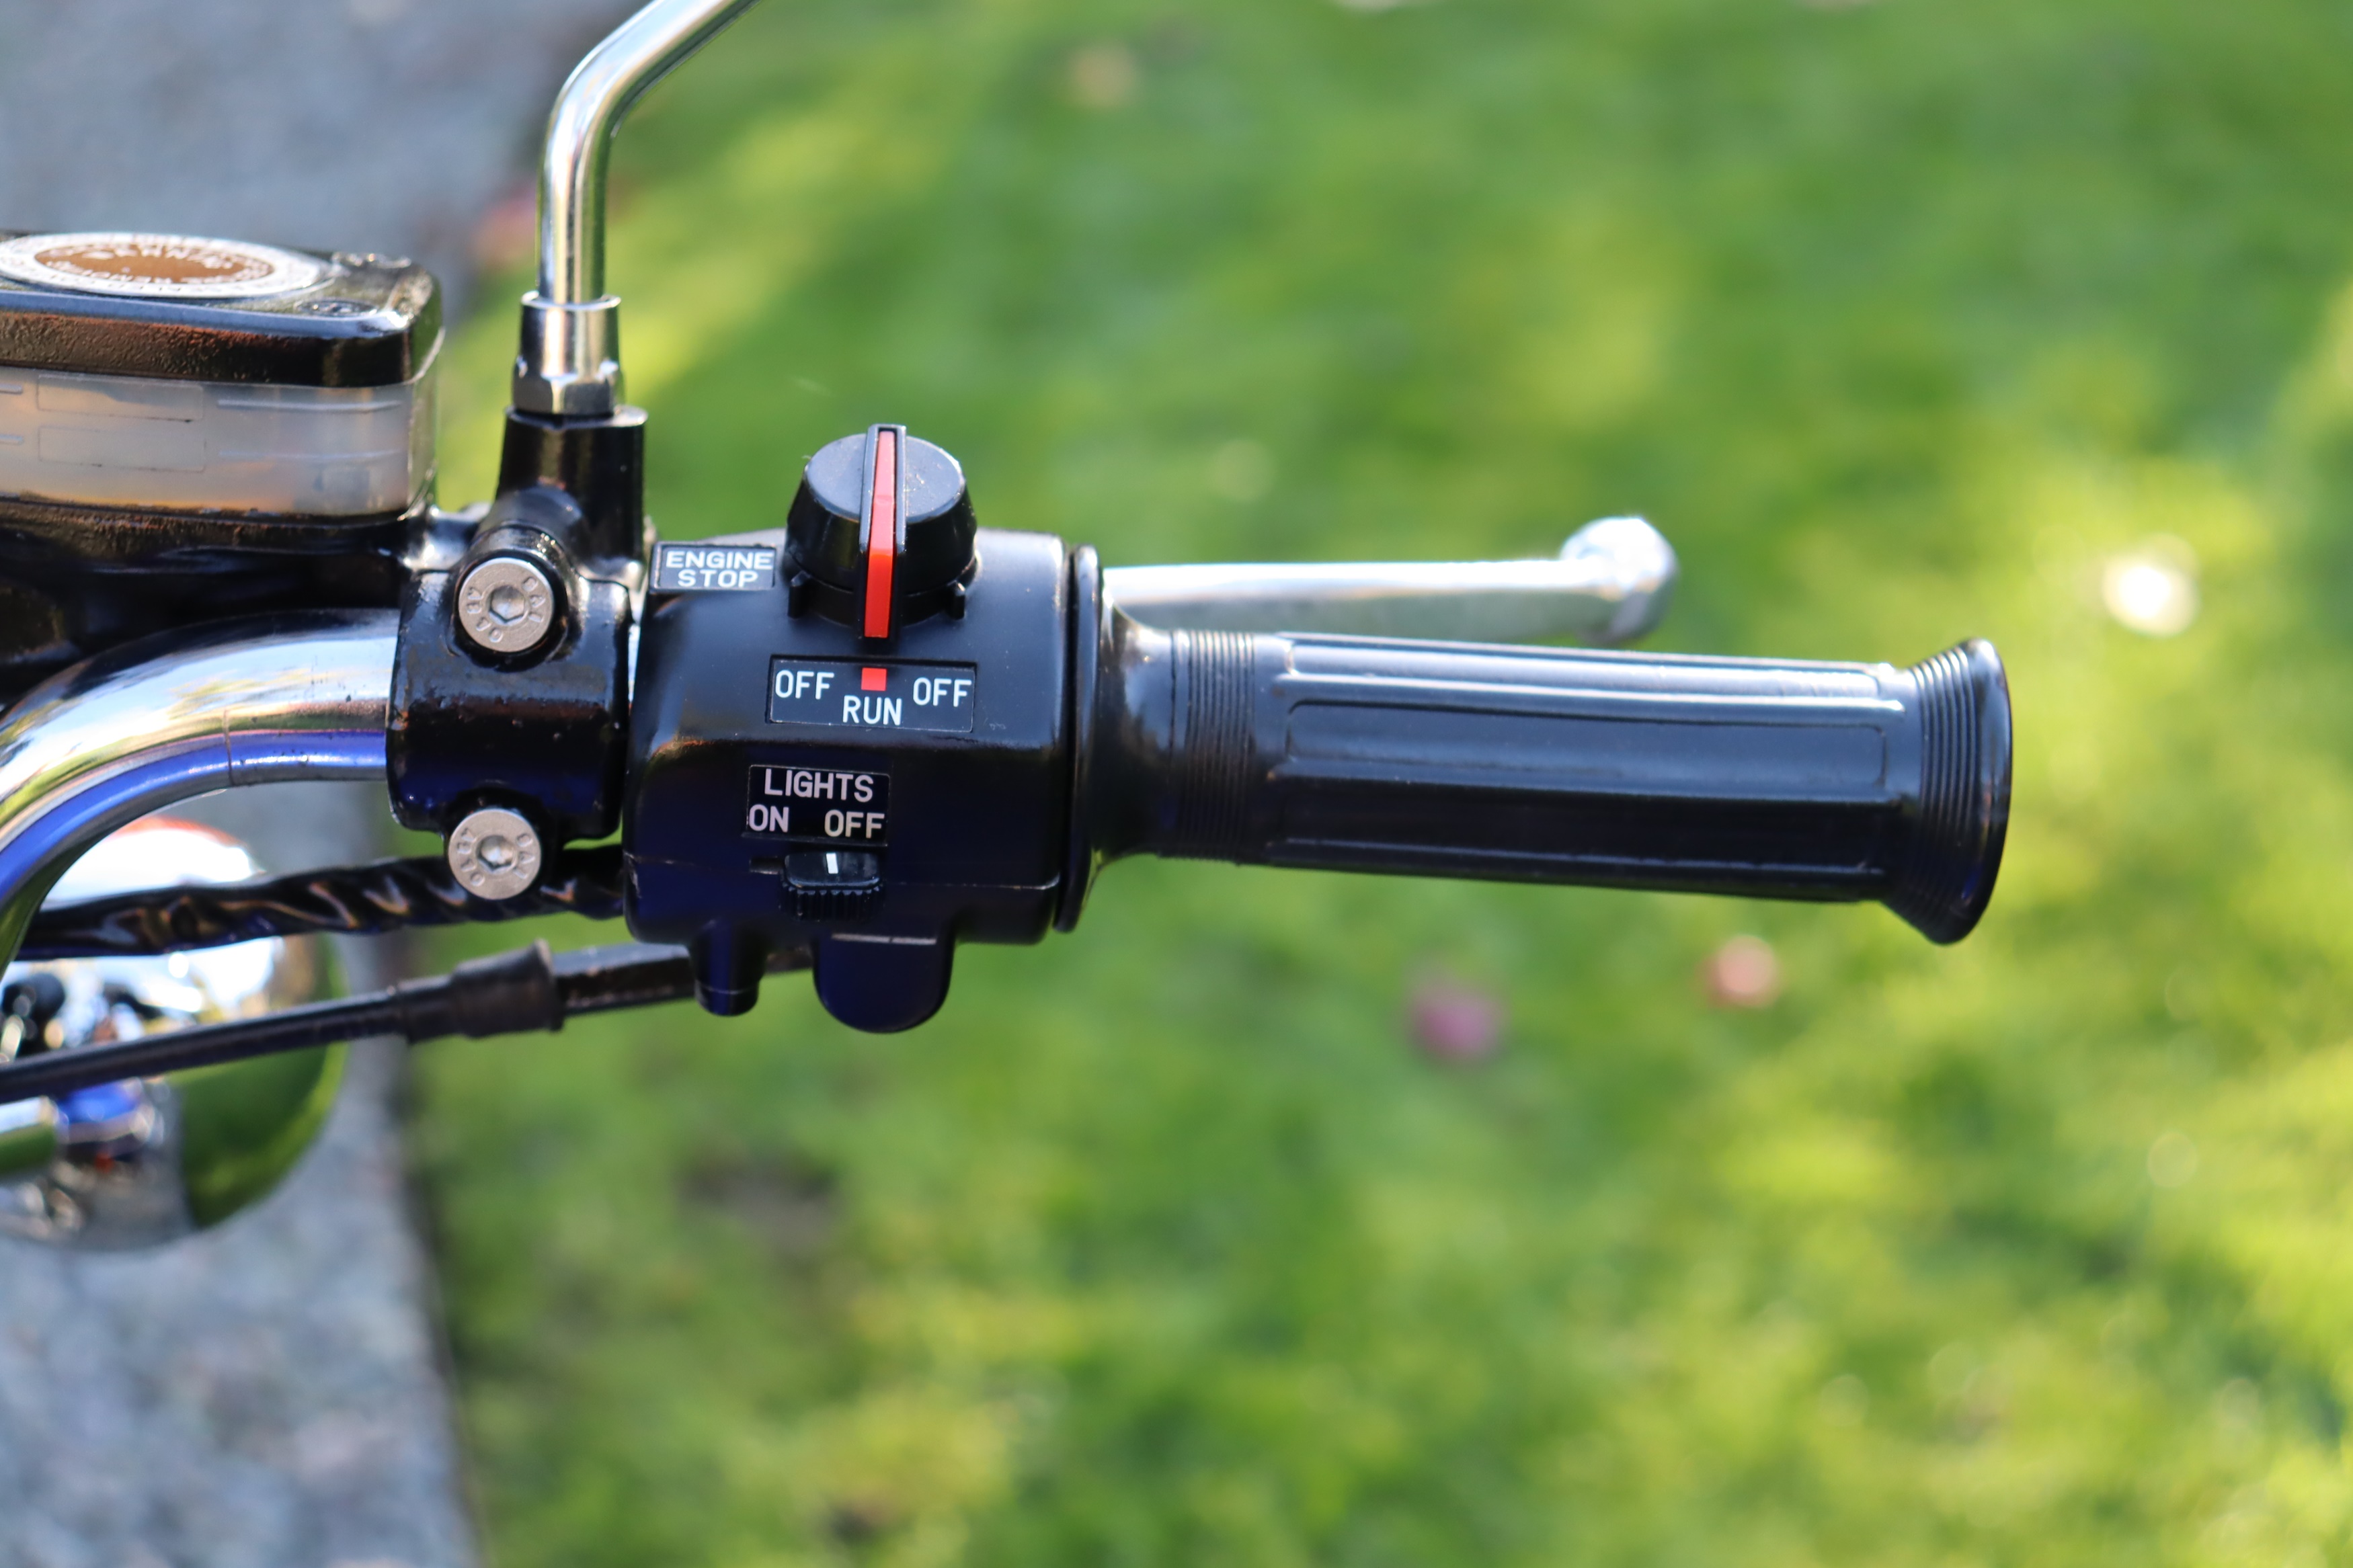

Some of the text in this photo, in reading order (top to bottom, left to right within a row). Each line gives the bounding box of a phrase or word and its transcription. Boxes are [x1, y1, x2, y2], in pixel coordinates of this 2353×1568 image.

[666, 551, 773, 570] ENGINE
[678, 570, 758, 588] STOP
[776, 670, 971, 707] OFF OFF
[843, 696, 902, 725] RUN
[765, 769, 873, 802] LIGHTS
[749, 804, 885, 838] ON OFF
